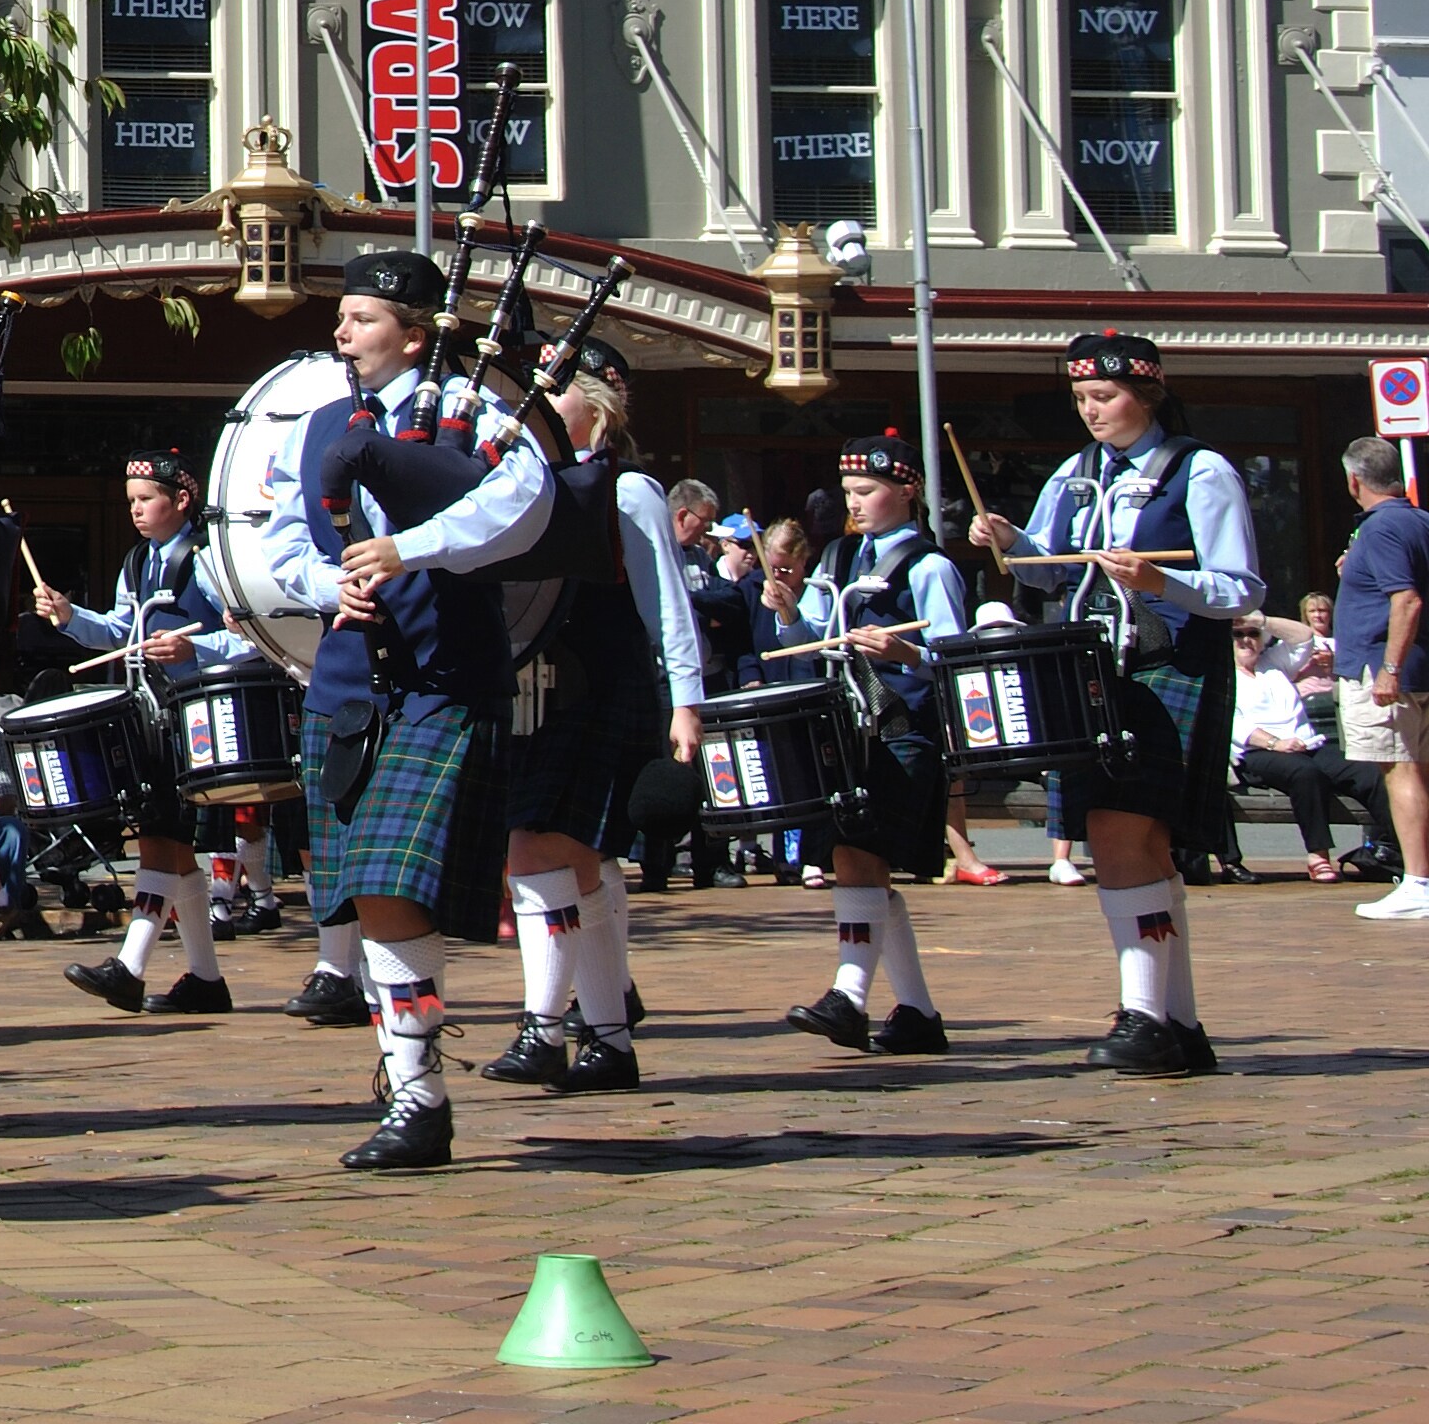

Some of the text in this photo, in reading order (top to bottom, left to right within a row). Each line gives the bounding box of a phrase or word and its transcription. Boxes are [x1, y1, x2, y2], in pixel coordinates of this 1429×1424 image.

[780, 4, 859, 31] HERE
[1078, 7, 1159, 36] NOW
[114, 121, 195, 148] HERE
[773, 131, 872, 162] THERE
[1079, 138, 1160, 166] NOW
[1002, 662, 1031, 745] PREMIER
[218, 696, 239, 763] PREMIER
[43, 739, 70, 805] PREMIER
[742, 727, 770, 805] PREMIER
